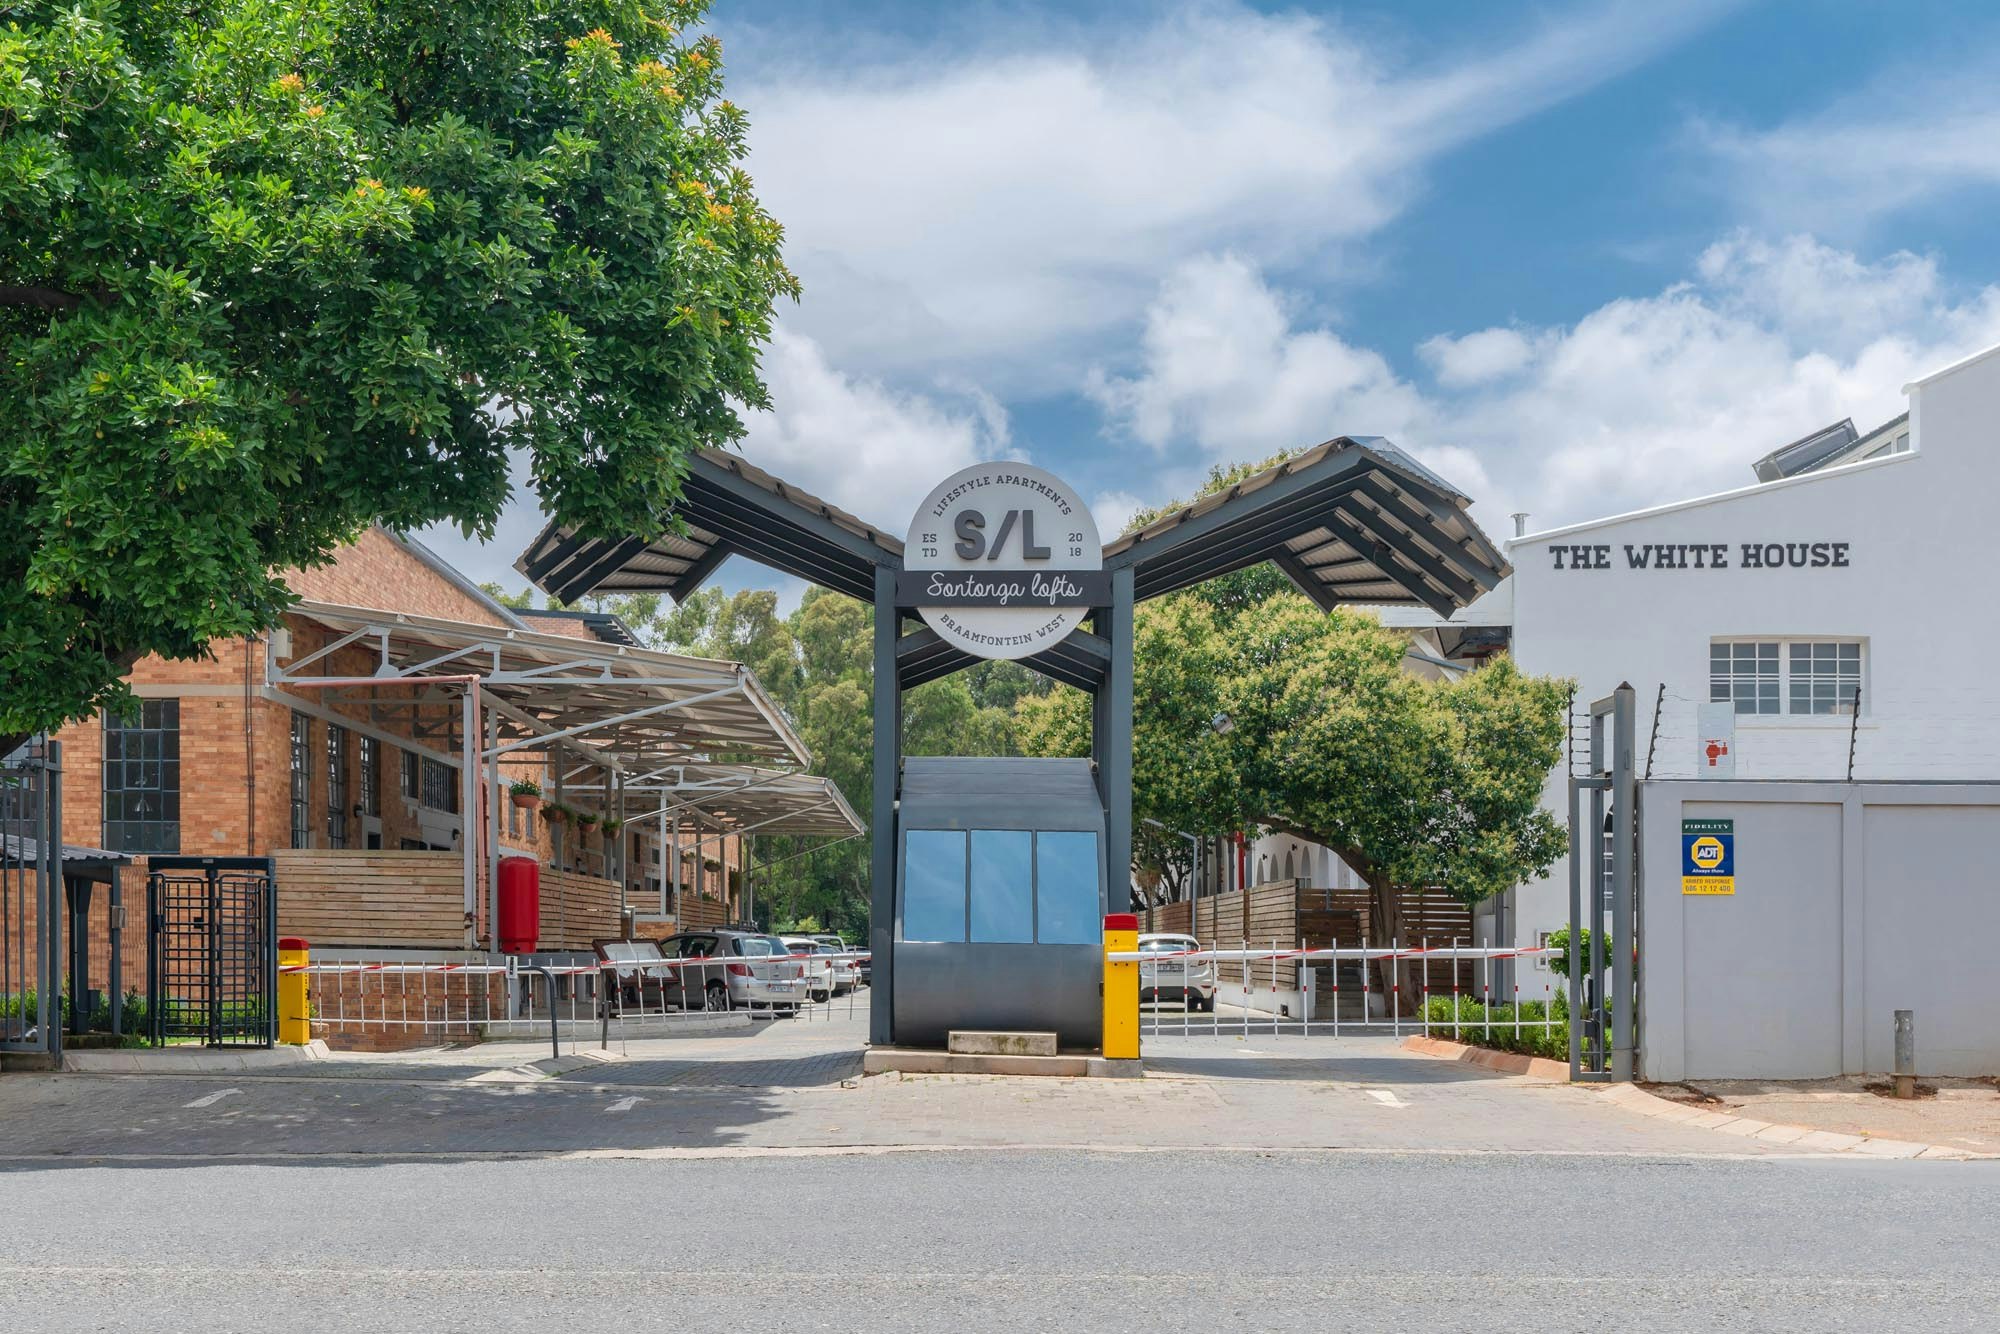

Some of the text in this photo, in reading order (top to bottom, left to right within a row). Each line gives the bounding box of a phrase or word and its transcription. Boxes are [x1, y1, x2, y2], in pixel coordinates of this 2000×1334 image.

[933, 475, 1072, 518] LIFESTYLE APARTMENTS
[922, 533, 937, 543] ES
[954, 509, 1052, 560] S/L
[1068, 532, 1083, 542] 20
[922, 548, 938, 558] TD
[1069, 548, 1082, 557] 18
[1549, 543, 1850, 569] THE WHITE HOUSE
[926, 571, 1083, 605] Sontonga lofts
[939, 613, 1066, 646] BRAAMFONTEIN WEST
[1698, 847, 1718, 858] ADT
